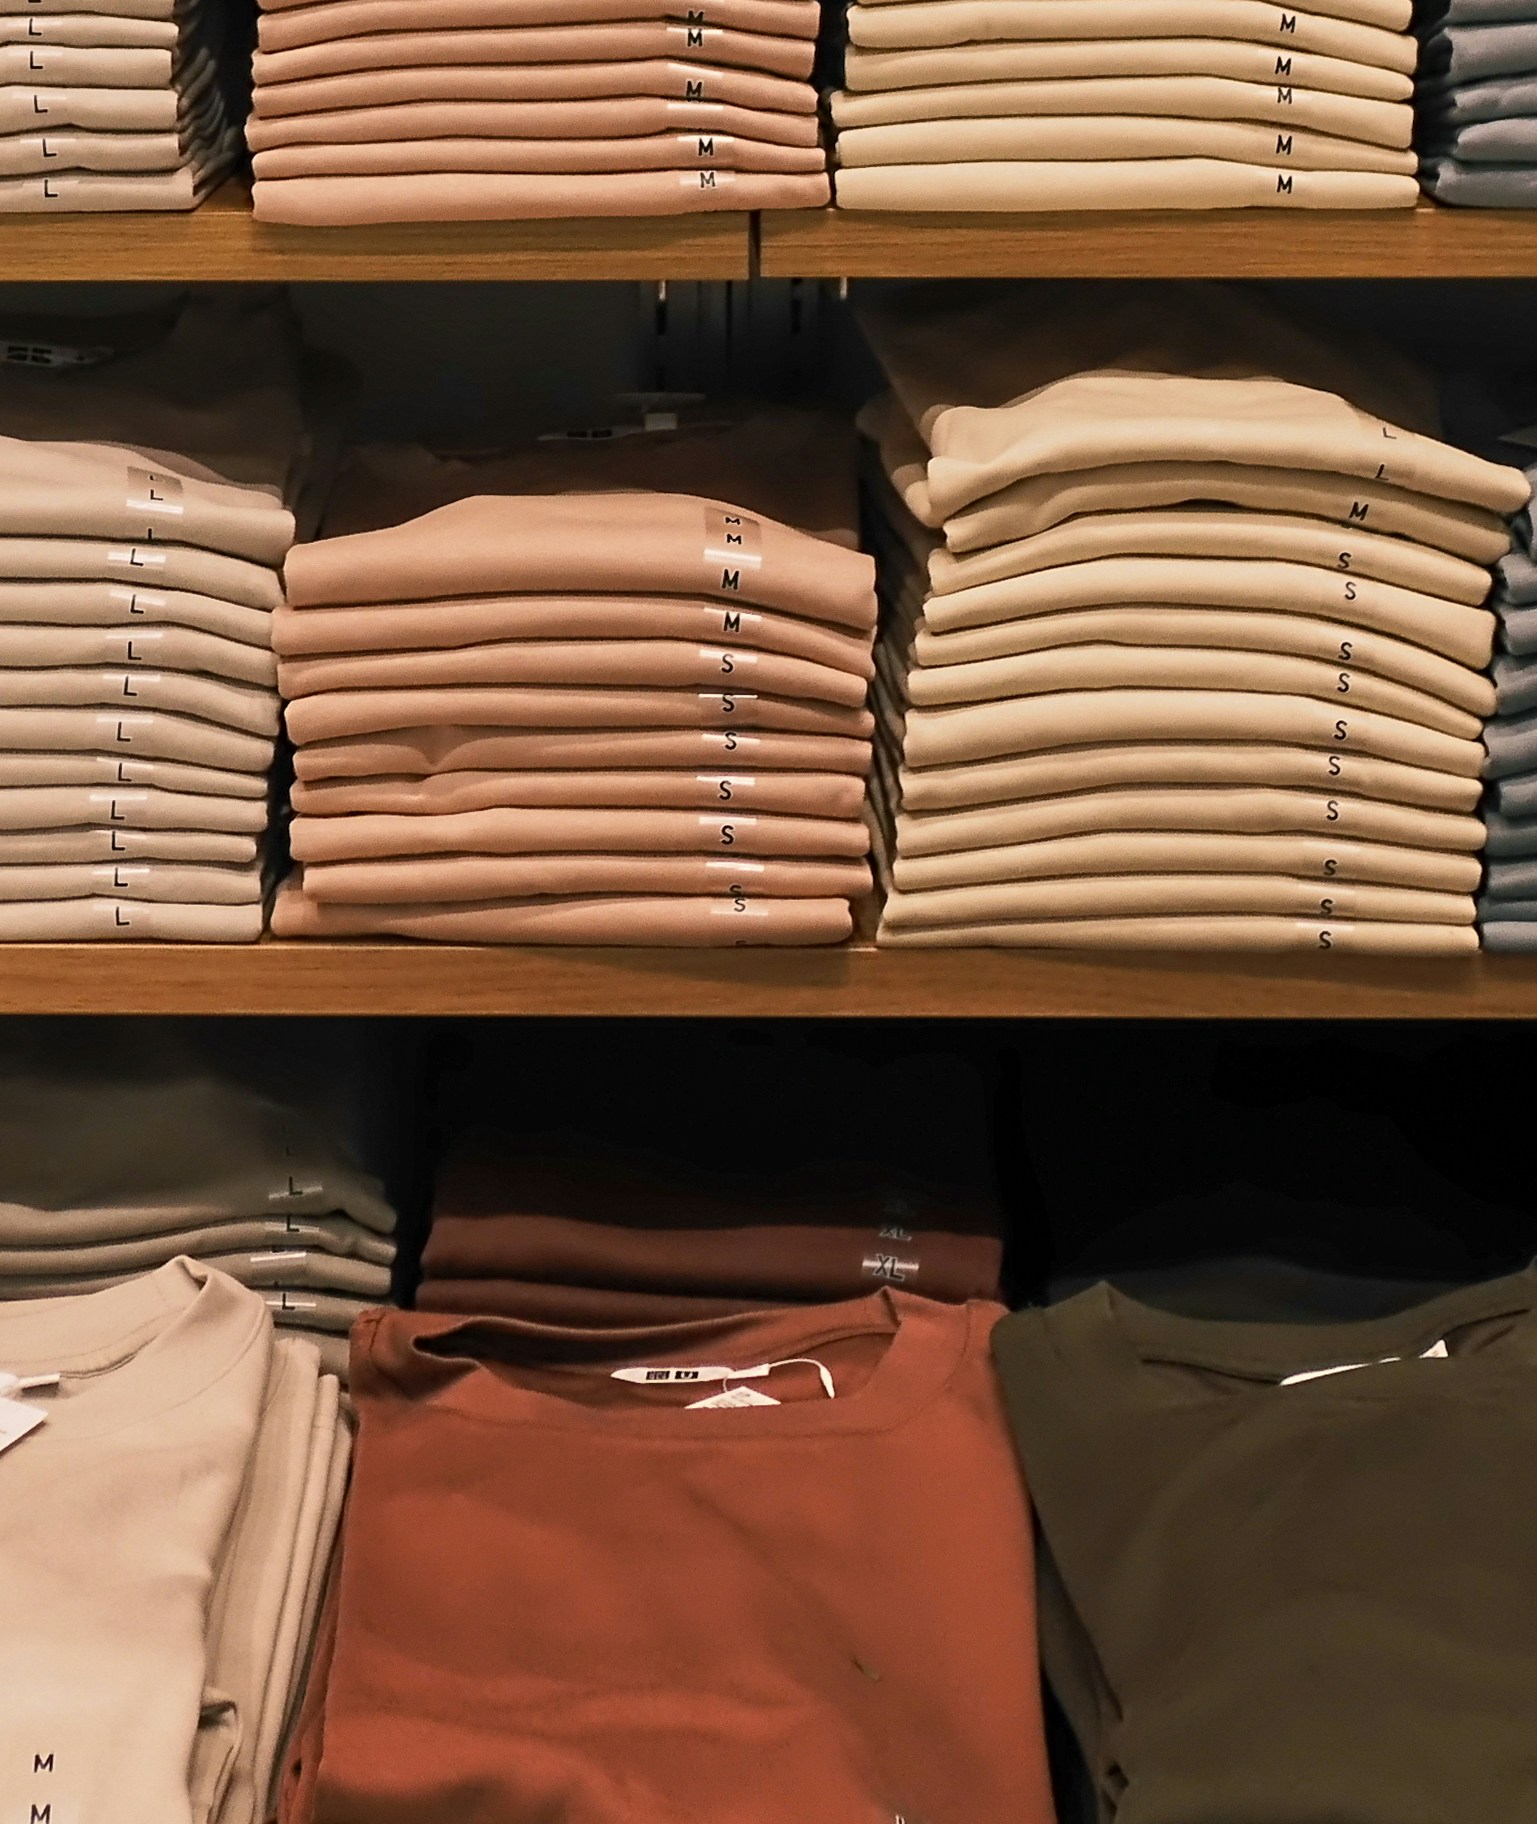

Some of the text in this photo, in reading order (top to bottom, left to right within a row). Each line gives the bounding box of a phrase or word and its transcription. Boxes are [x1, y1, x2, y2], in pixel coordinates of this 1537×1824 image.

[1280, 13, 1295, 33] M
[687, 28, 703, 47] M
[31, 51, 43, 69] L
[1275, 56, 1291, 75] M
[34, 95, 48, 113] L
[698, 138, 713, 156] M
[1276, 135, 1292, 155] M
[45, 180, 58, 197] L
[1277, 174, 1292, 194] M
[1349, 501, 1369, 521] M
[727, 534, 741, 544] M
[722, 569, 739, 590] M
[1344, 581, 1356, 600] S
[130, 595, 144, 613] L
[724, 611, 740, 632] M
[128, 641, 141, 660] L
[721, 654, 734, 673] S
[124, 676, 137, 696] L
[1337, 673, 1350, 693] S
[1334, 720, 1347, 740] S
[725, 732, 736, 750] S
[719, 781, 731, 800] S
[111, 800, 124, 820] L
[1326, 800, 1338, 821] S
[115, 867, 128, 886] L
[116, 907, 130, 926] L
[1318, 931, 1332, 949] S
[289, 1176, 303, 1195] L
[286, 1215, 300, 1232] L
[874, 1253, 905, 1282] XL
[282, 1293, 295, 1310] L
[34, 1754, 54, 1773] M
[30, 1804, 51, 1824] M
